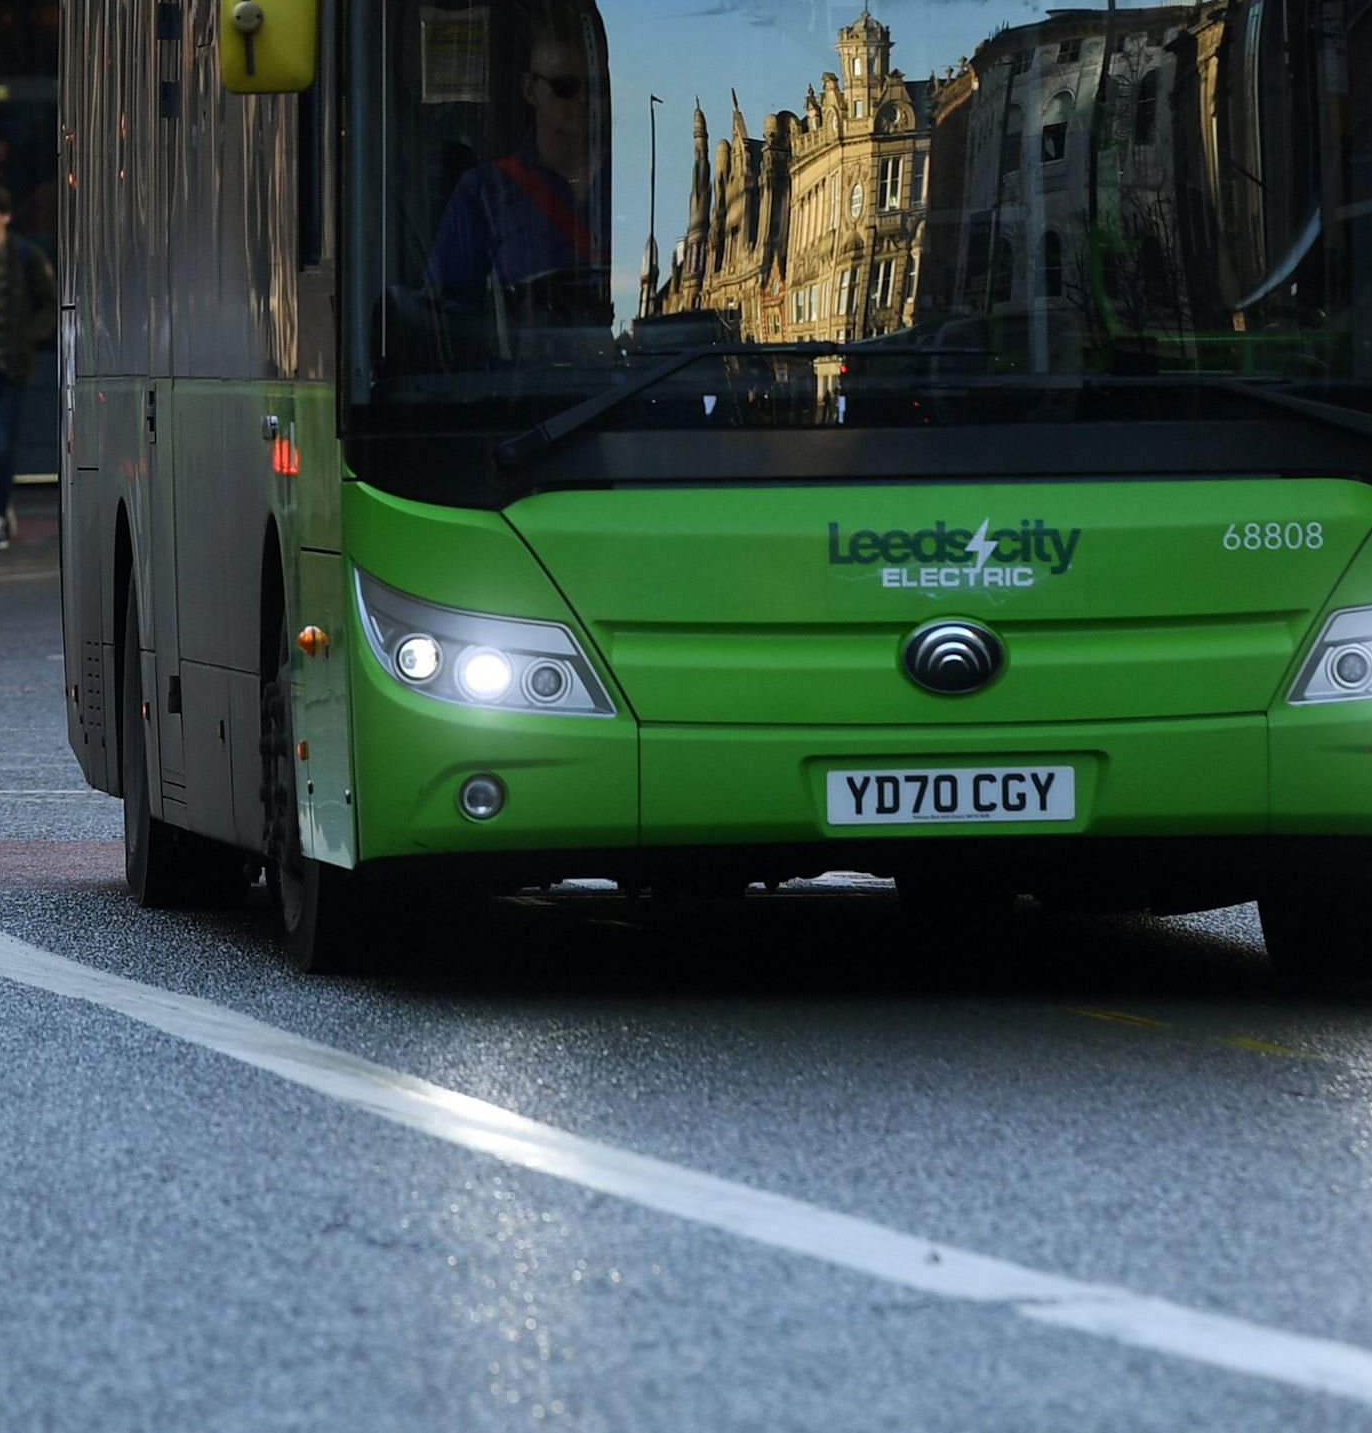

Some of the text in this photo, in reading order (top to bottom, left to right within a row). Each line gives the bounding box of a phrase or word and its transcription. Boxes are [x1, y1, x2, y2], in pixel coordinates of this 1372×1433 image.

[1222, 521, 1325, 551] 68808
[881, 566, 1035, 588] ELECTRIC
[846, 772, 1056, 816] YD70 CGY
